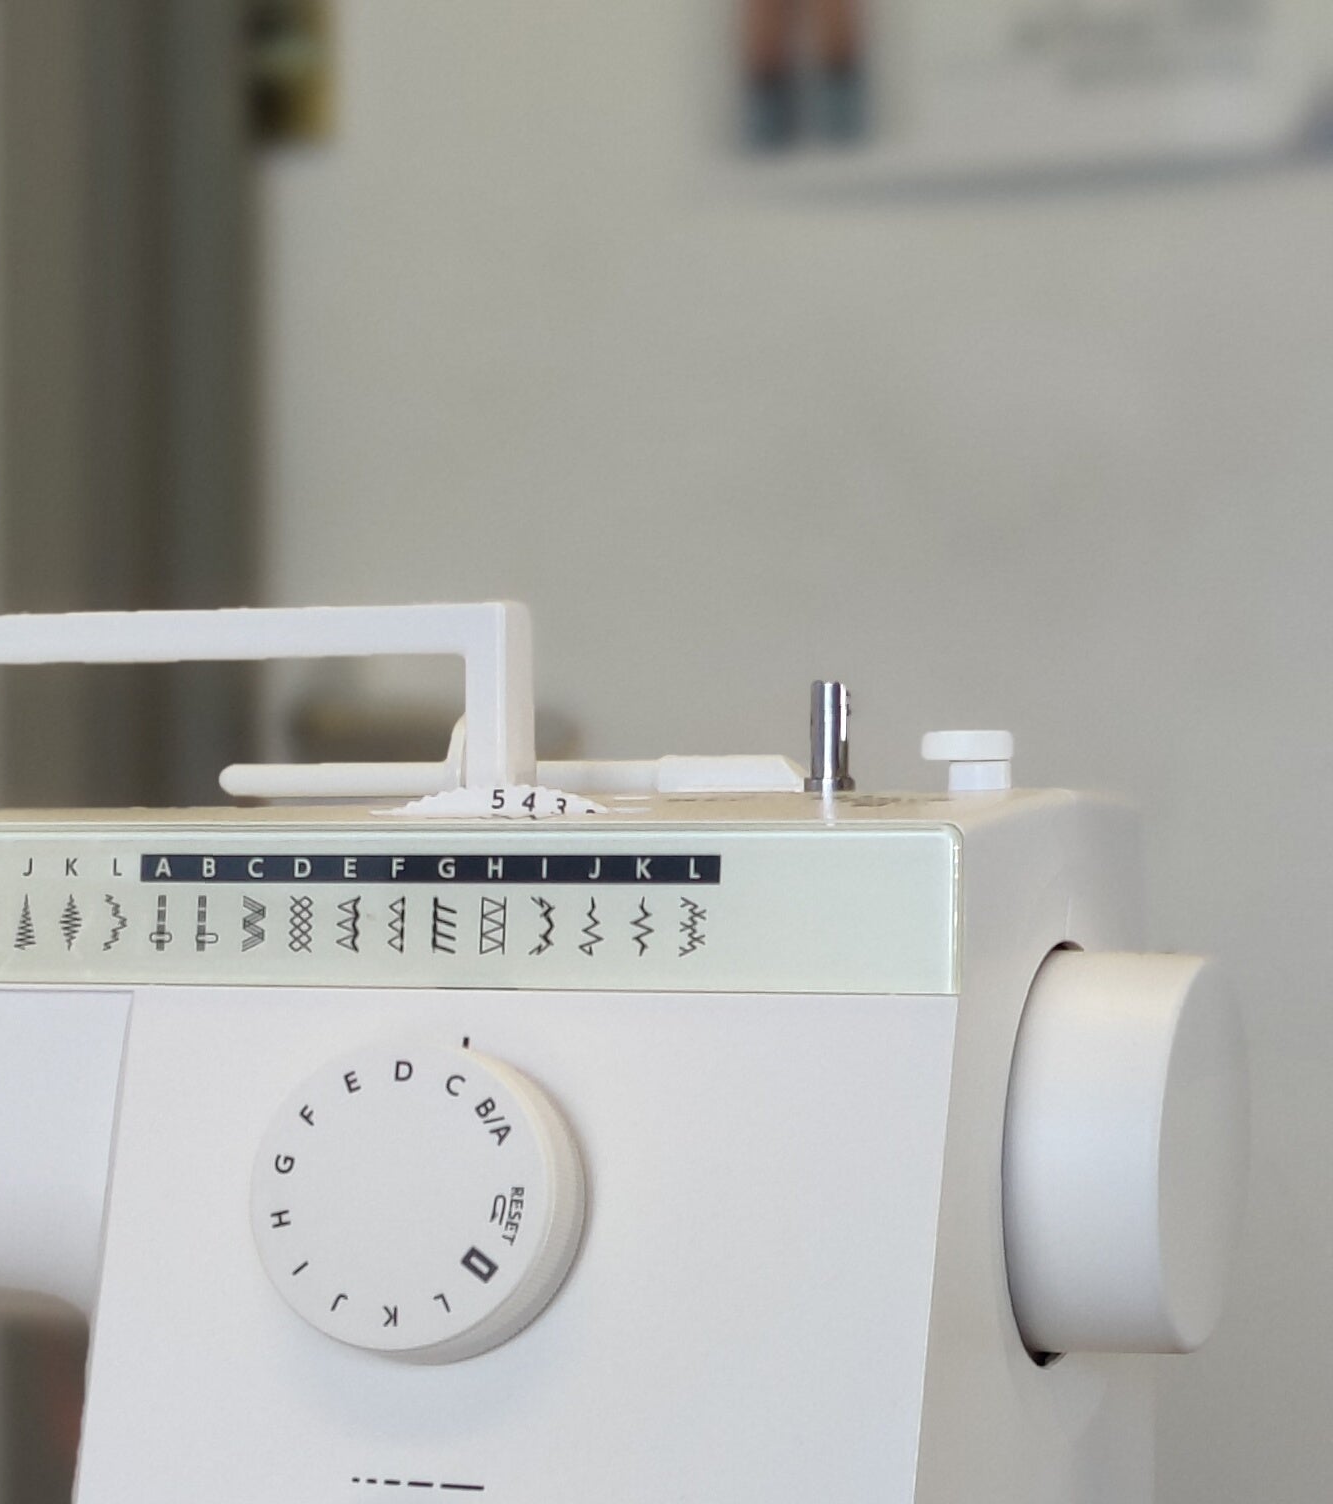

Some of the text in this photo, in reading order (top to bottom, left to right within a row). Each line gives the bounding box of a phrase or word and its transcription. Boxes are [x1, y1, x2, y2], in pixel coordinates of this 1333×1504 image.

[491, 789, 505, 810] 5
[522, 792, 536, 812] 4
[23, 857, 33, 877] J
[65, 858, 78, 877] K
[113, 857, 122, 877] L
[156, 857, 171, 876] A
[203, 857, 215, 877] B
[249, 857, 263, 877] C
[295, 858, 311, 877] D
[345, 857, 356, 877] E
[392, 857, 404, 877] F
[439, 858, 455, 878] G
[488, 857, 502, 878] H
[589, 857, 600, 878] J
[637, 857, 650, 878] K
[690, 857, 700, 878] L
[271, 1061, 511, 1327] L K J I H G F E D C B/A
[502, 1187, 525, 1245] RESET
